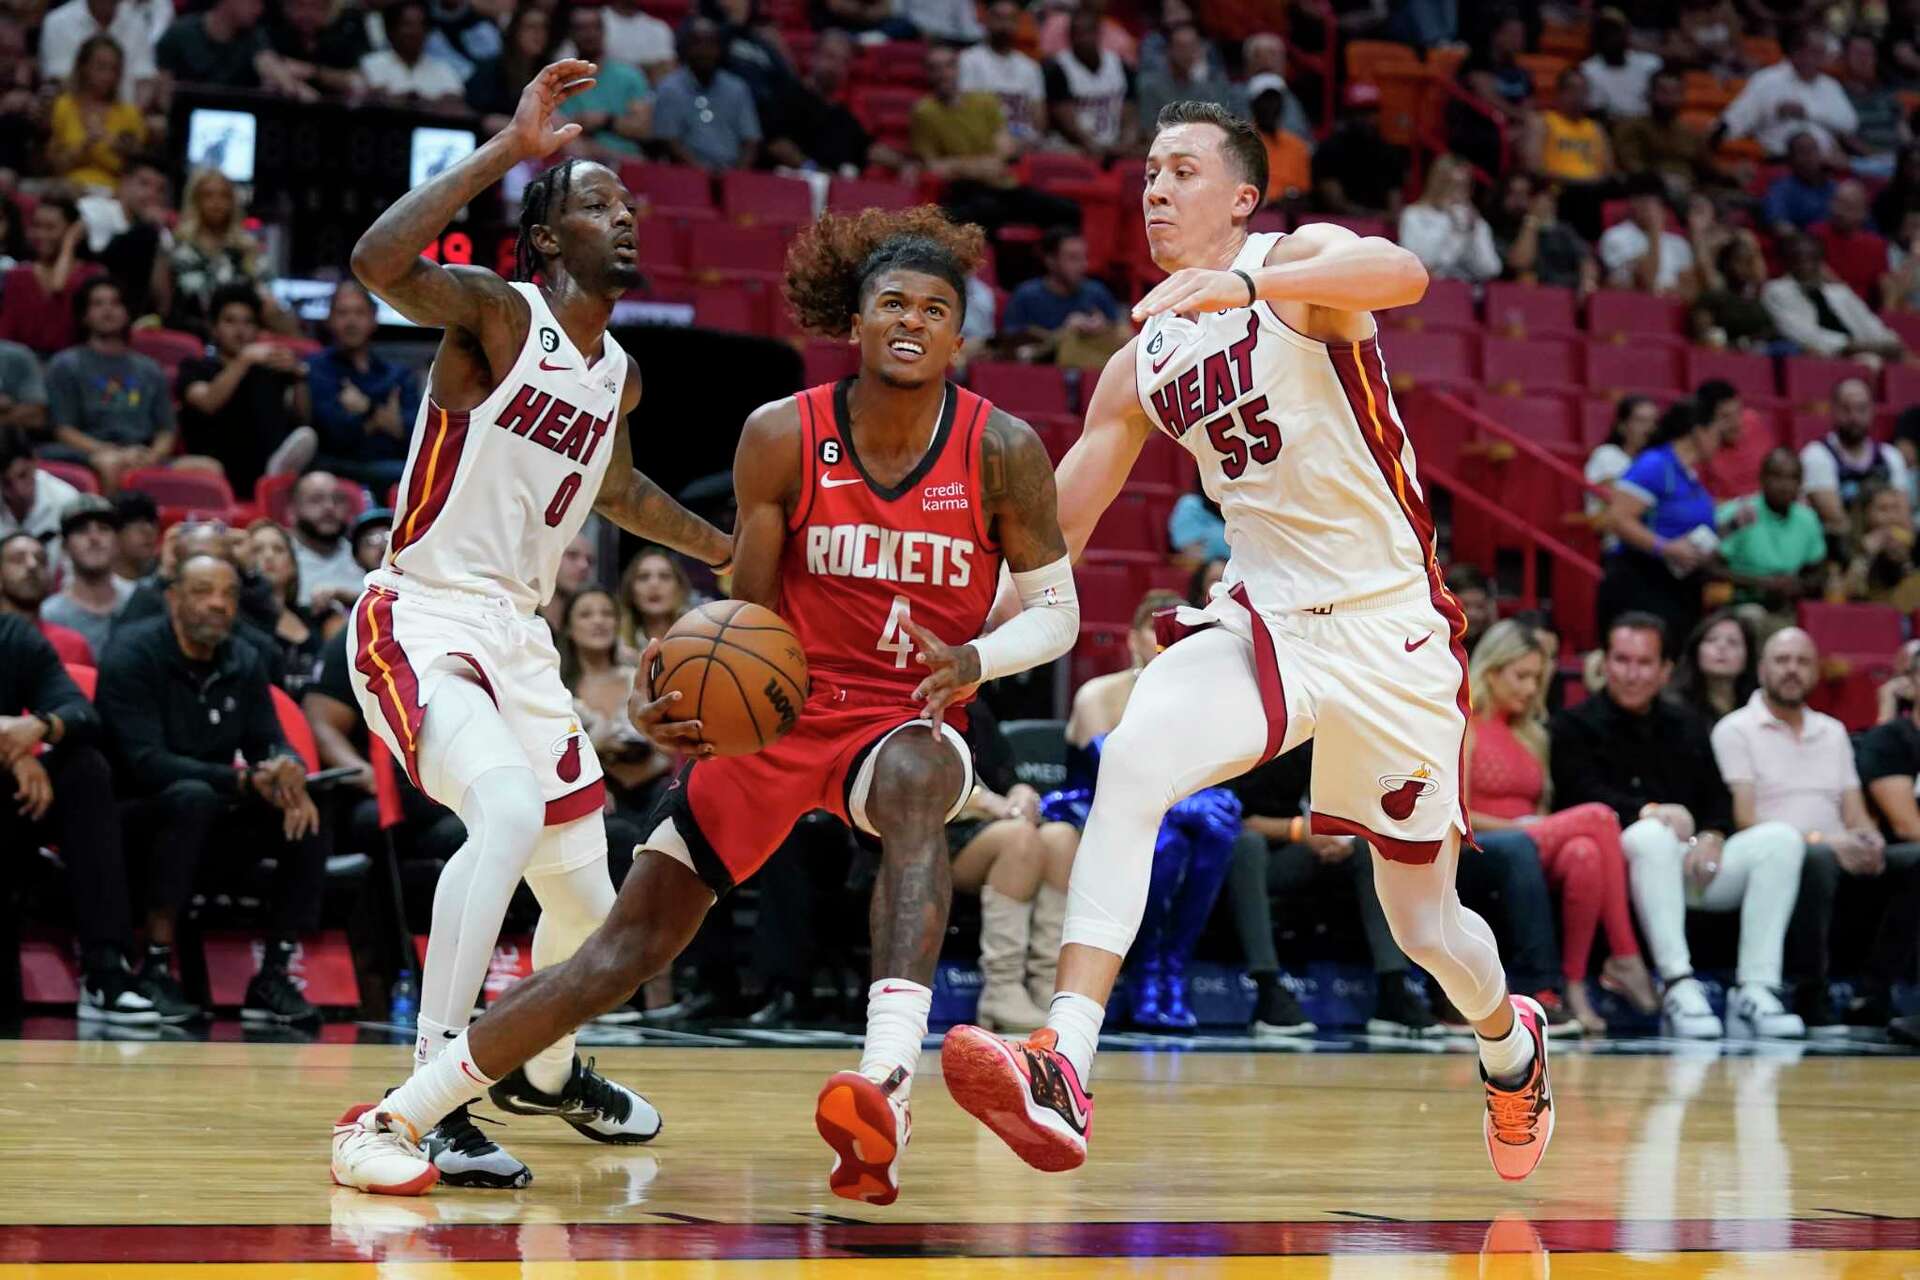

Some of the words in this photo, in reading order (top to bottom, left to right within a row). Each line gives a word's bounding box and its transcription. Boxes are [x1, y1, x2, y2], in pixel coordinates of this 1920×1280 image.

[541, 330, 556, 350] 6
[1150, 309, 1260, 440] HEAT
[495, 384, 614, 466] HEAT
[823, 441, 839, 463] 6
[1205, 394, 1283, 481] 55
[545, 471, 582, 528] 0
[922, 498, 968, 512] karma
[923, 482, 965, 497] credit
[807, 523, 974, 588] ROCKETS
[877, 595, 914, 669] 4
